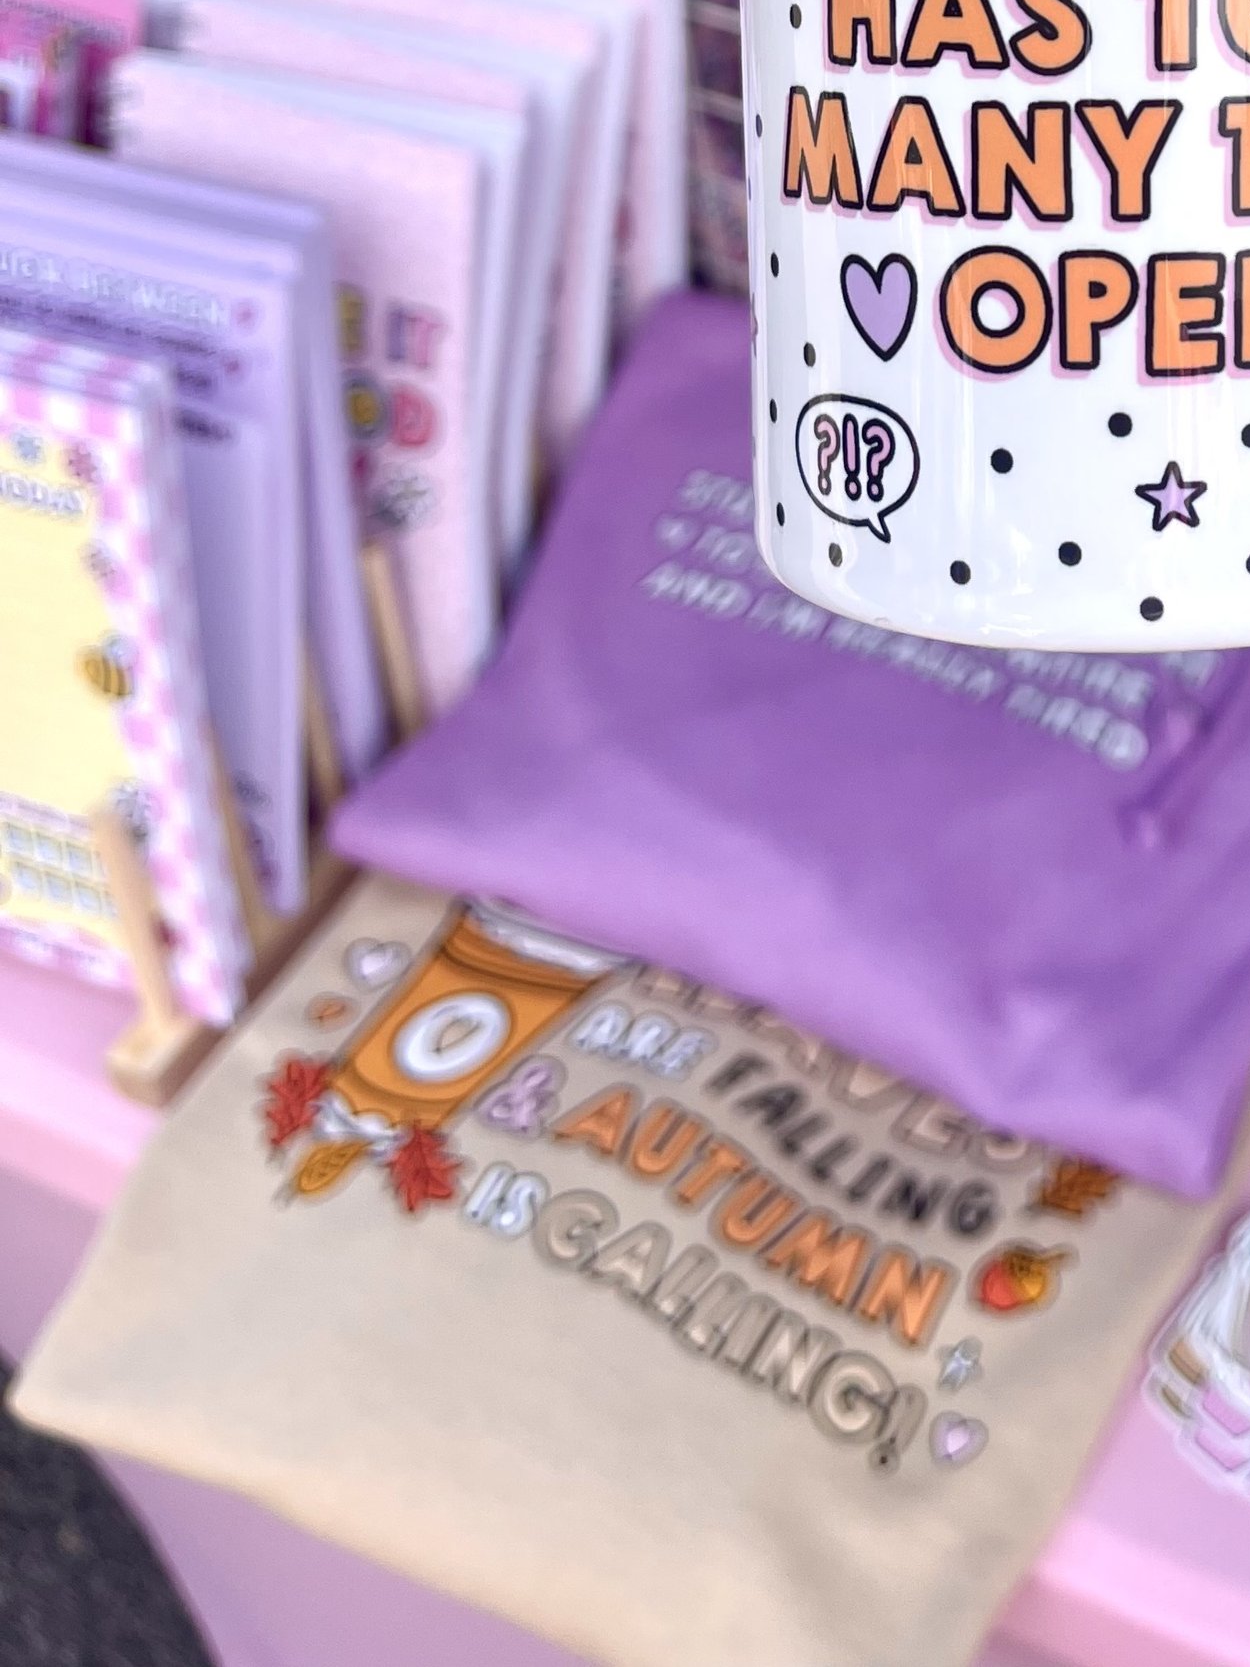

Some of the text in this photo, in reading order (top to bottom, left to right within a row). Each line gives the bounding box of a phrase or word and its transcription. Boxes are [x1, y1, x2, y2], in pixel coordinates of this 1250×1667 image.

[784, 88, 1181, 221] MANY
[570, 1003, 716, 1082] ARE
[551, 1084, 958, 1348] AUTUMN
[704, 1051, 1000, 1237] FALLING
[463, 1161, 929, 1475] IS CALLING!
